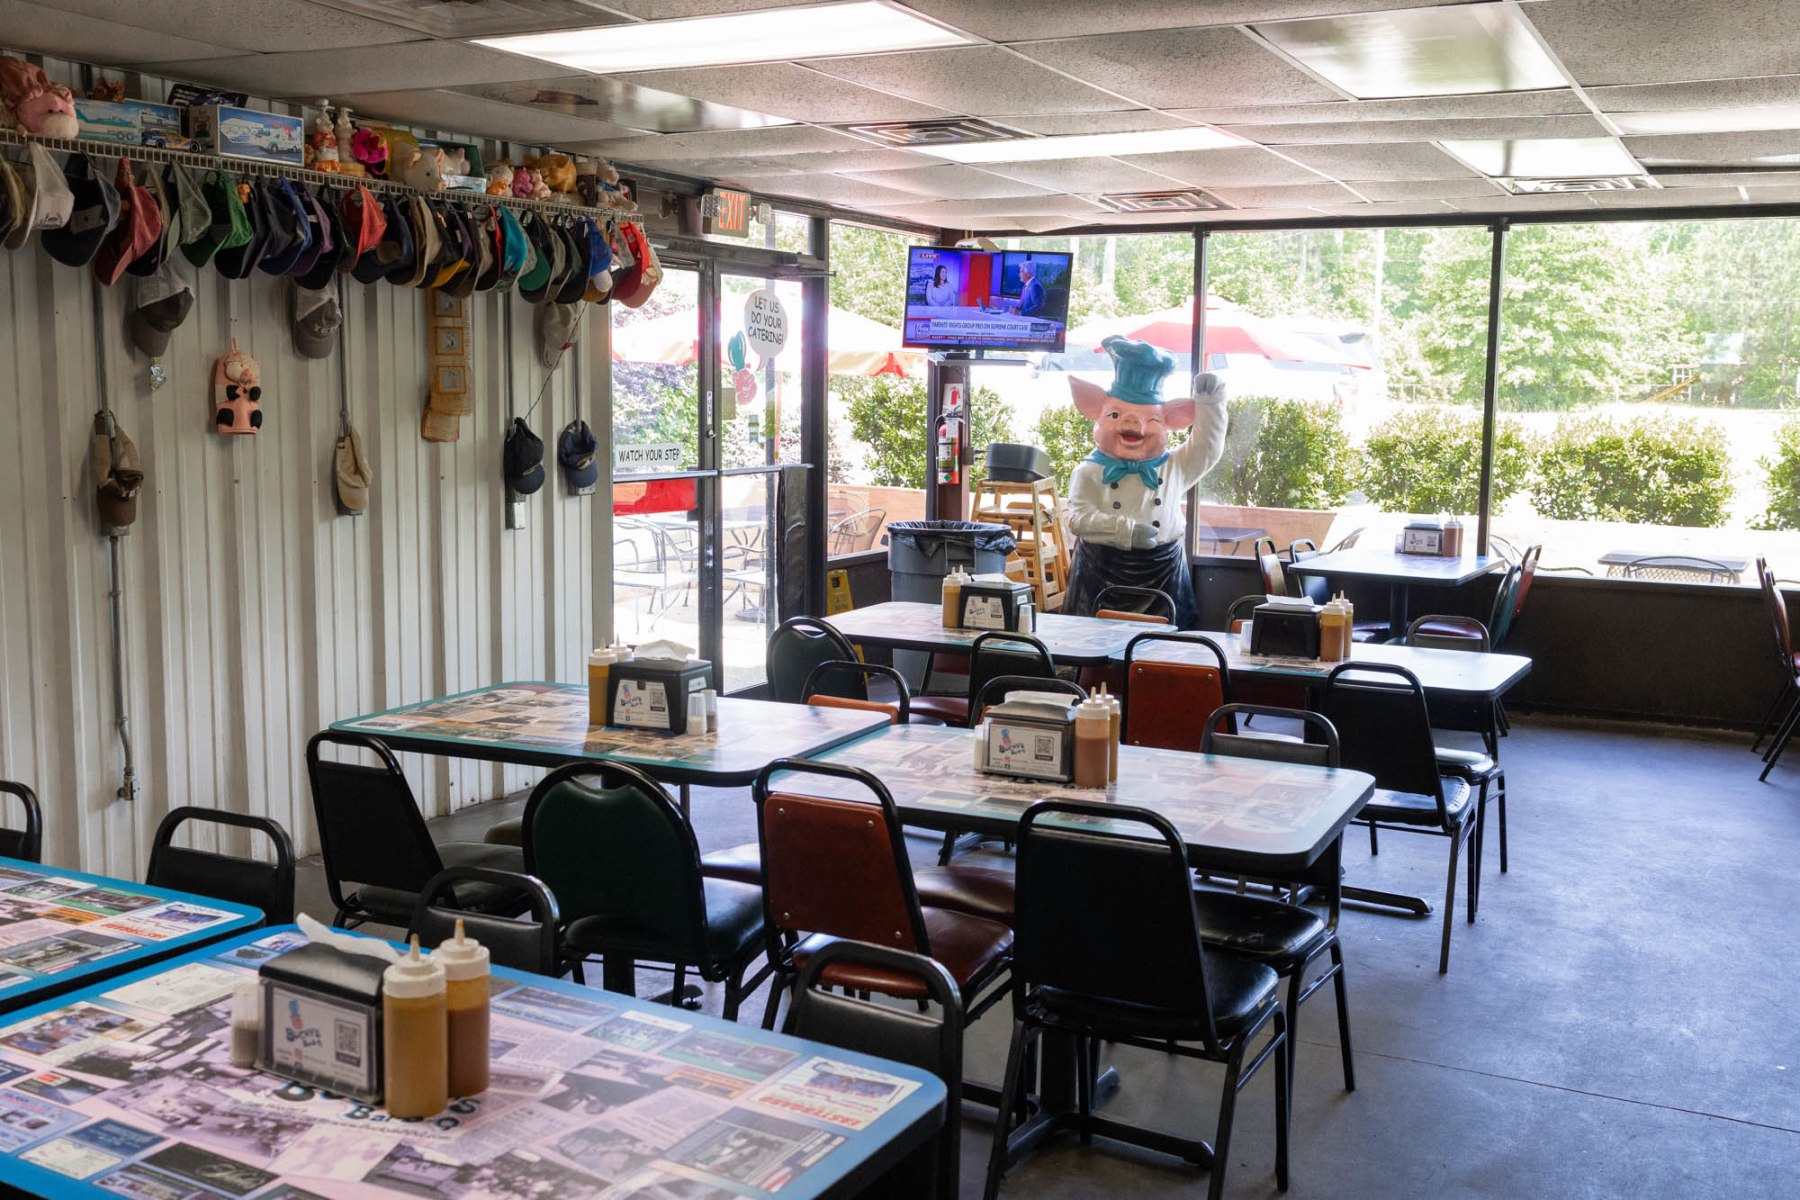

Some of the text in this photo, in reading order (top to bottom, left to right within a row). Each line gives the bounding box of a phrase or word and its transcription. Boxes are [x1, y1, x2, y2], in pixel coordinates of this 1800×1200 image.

[719, 191, 747, 231] EXIT
[754, 296, 780, 314] LET US
[751, 310, 782, 330] DO YOUR
[747, 325, 784, 345] CATERING!
[618, 447, 681, 463] WATCH YOUR STEP
